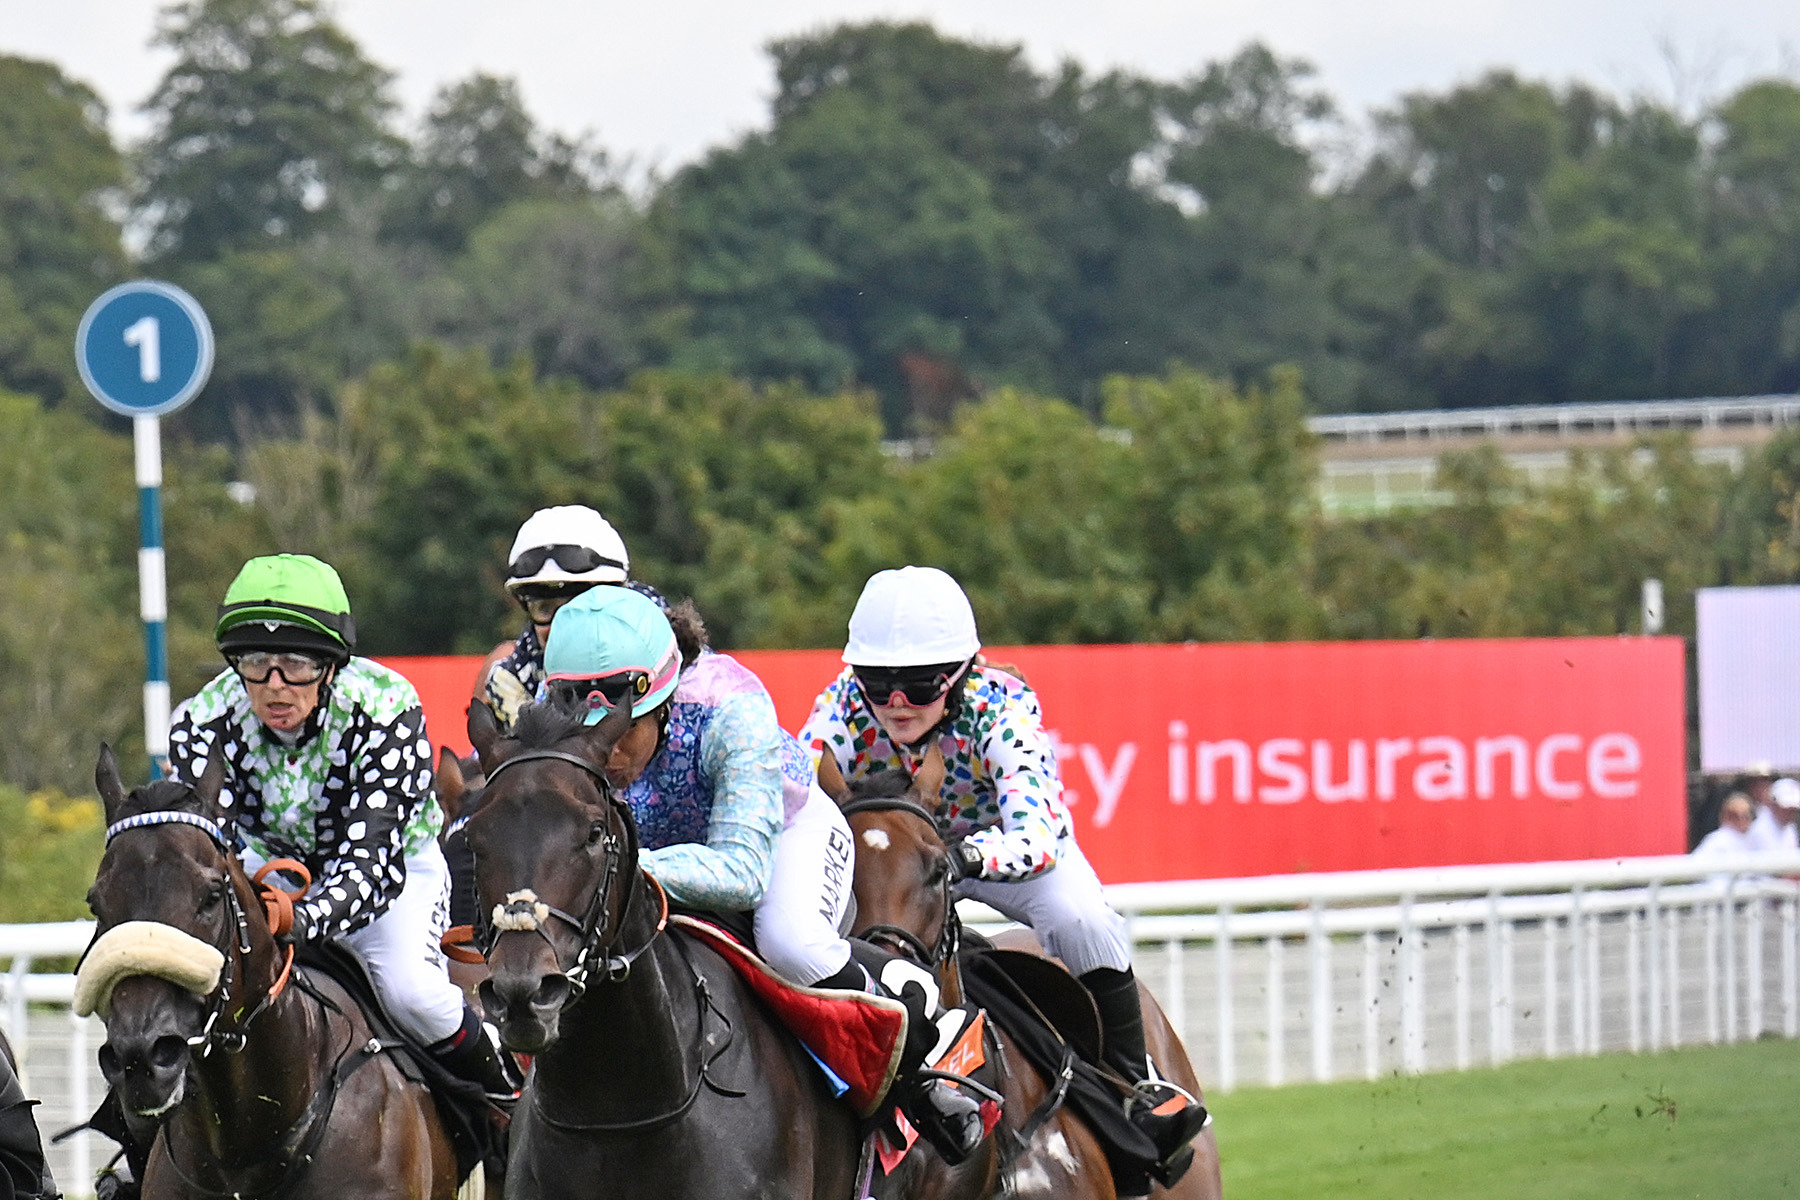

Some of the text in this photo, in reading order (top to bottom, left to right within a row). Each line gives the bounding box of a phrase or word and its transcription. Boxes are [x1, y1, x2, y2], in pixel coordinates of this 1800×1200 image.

[122, 316, 162, 384] 1
[1167, 719, 1642, 806] insurance
[818, 825, 852, 930] MARKEL
